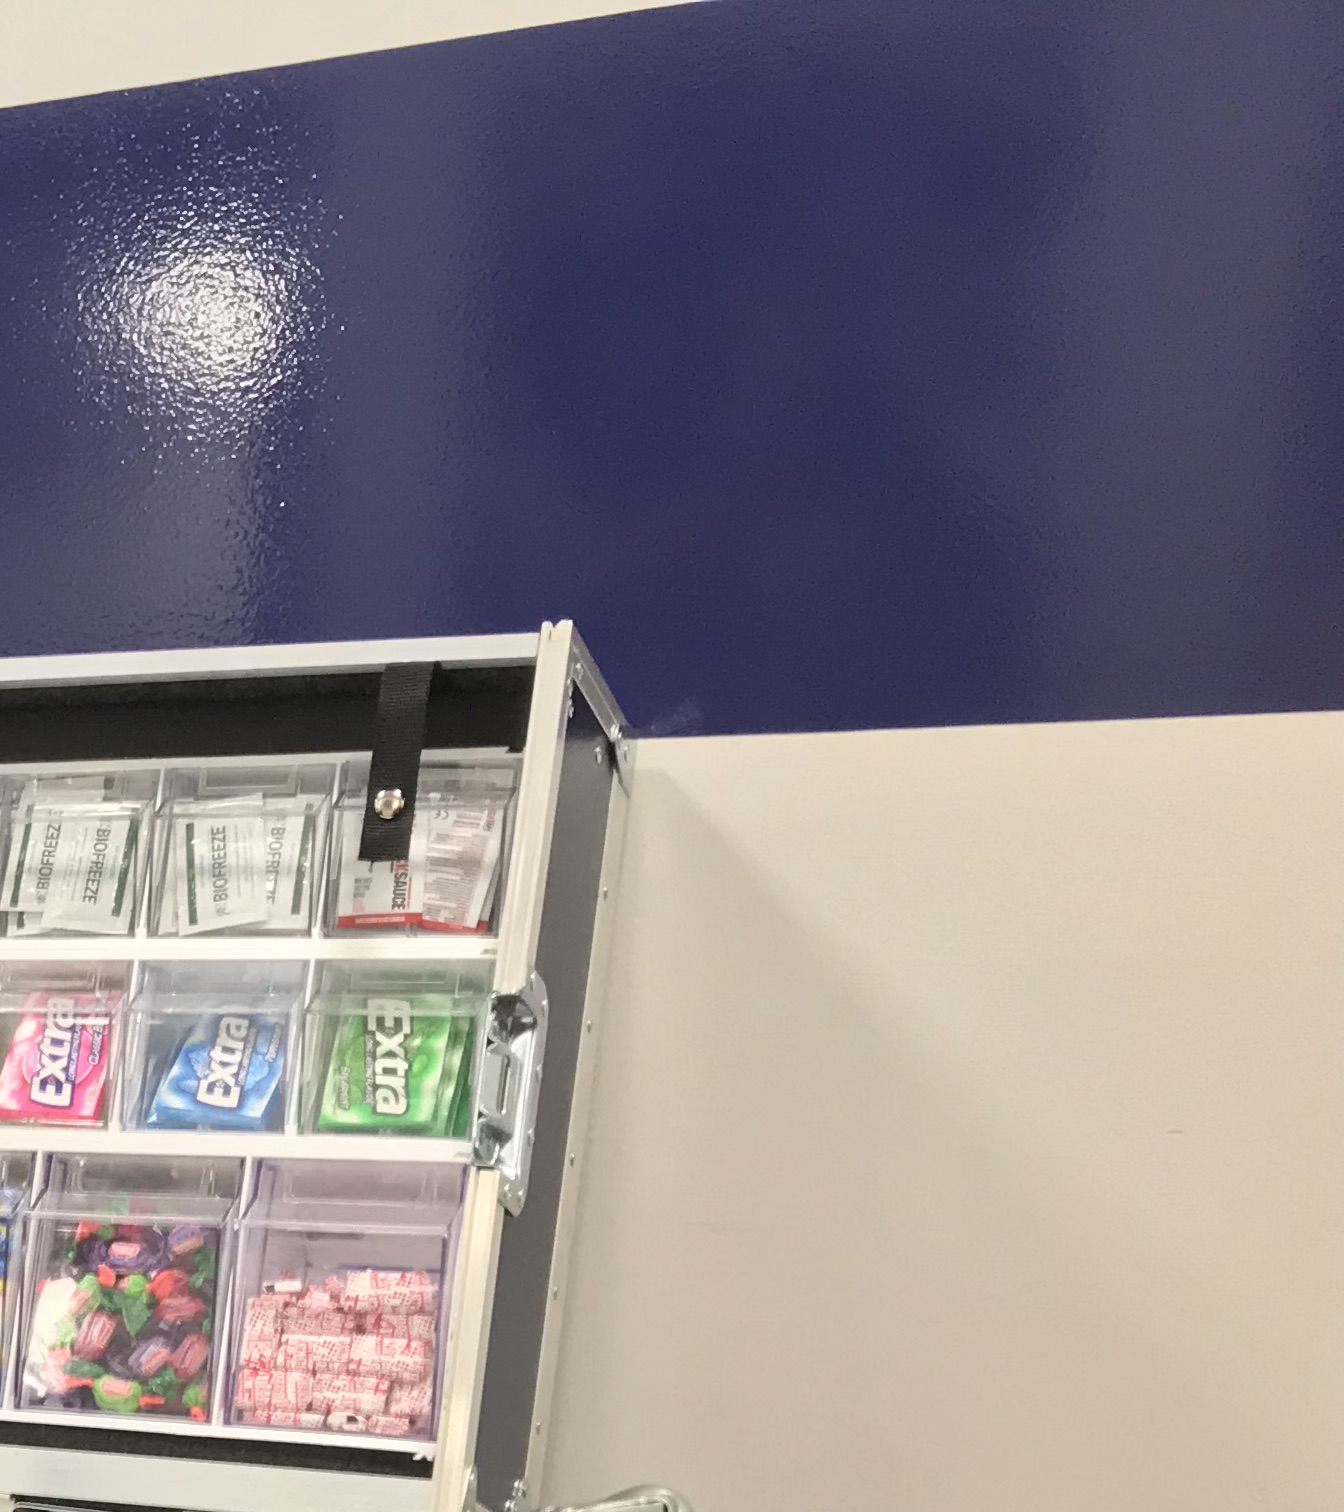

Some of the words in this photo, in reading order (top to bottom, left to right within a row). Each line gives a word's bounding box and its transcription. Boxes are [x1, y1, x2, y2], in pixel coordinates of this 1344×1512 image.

[81, 827, 111, 906] BIOFREEZE
[210, 825, 229, 903] BIOFREEZE
[30, 996, 75, 1107] Extra
[196, 1016, 250, 1108] Extra
[367, 999, 412, 1114] Extra
